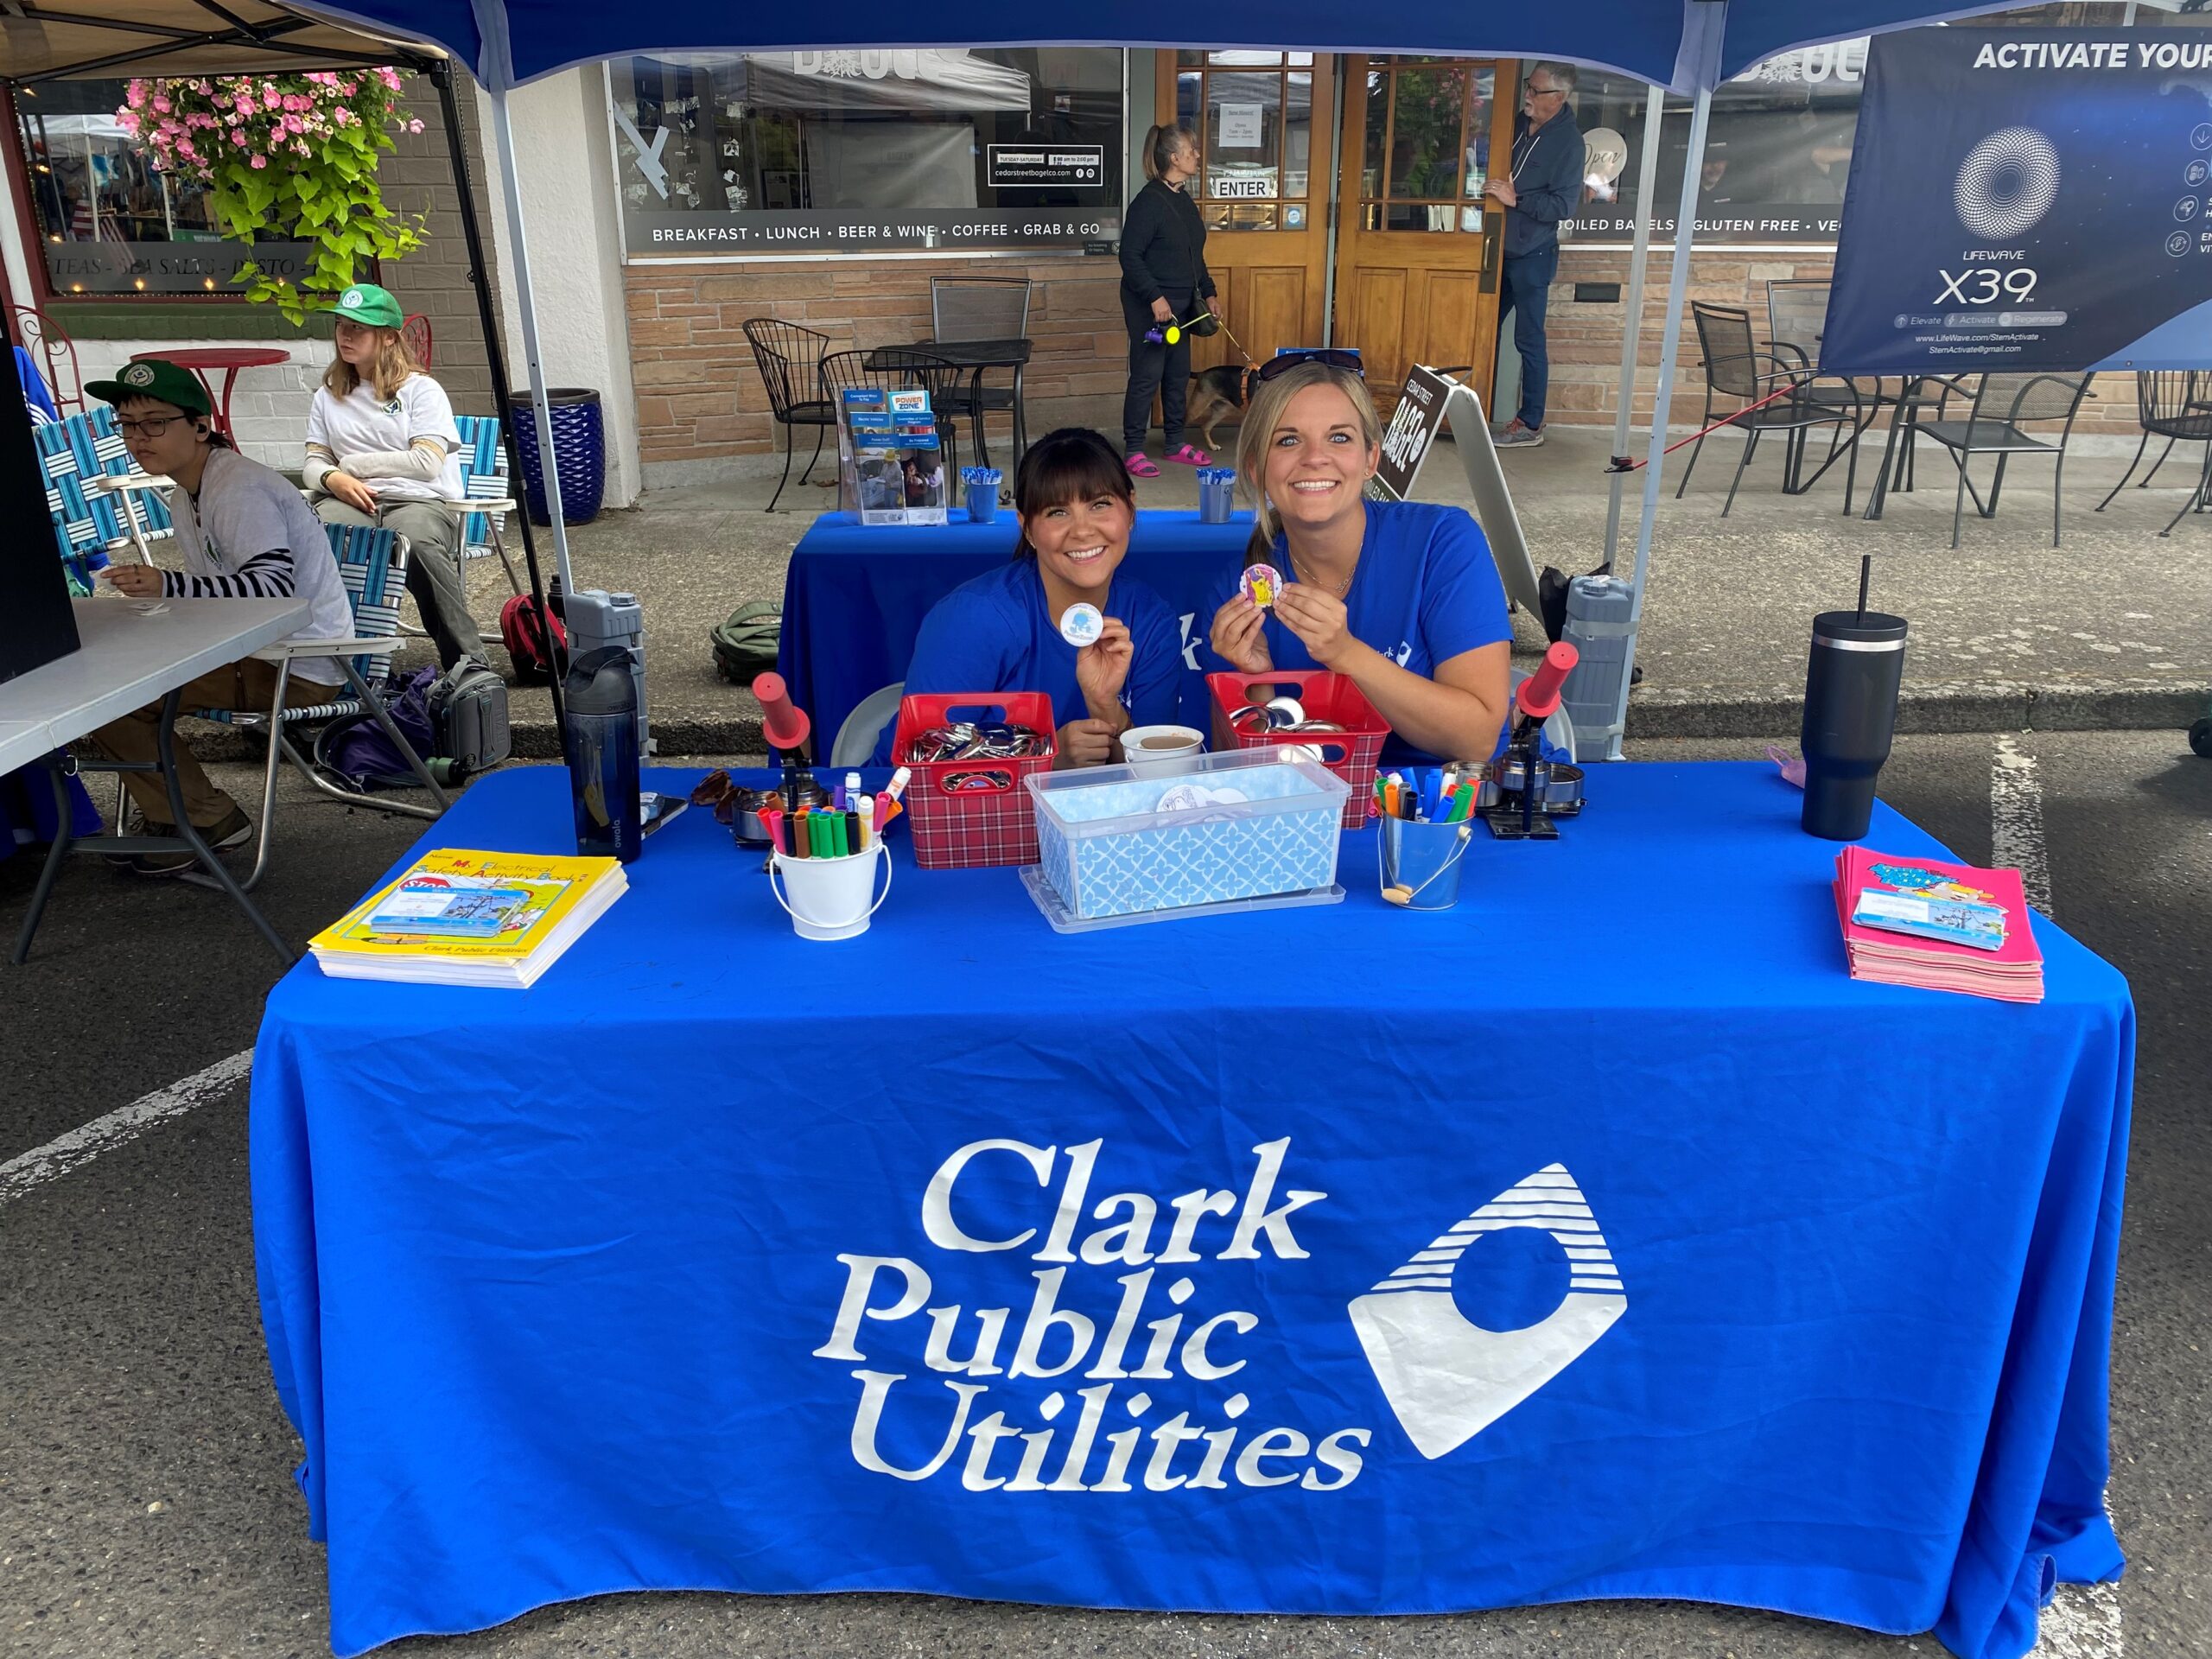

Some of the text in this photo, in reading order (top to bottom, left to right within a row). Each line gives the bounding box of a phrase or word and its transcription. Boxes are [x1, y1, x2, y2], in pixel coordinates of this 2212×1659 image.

[1973, 43, 2130, 68] ACTIVATE
[1219, 181, 1266, 196] ENTER
[652, 223, 1099, 242] BREAKFAST LUNCH BEER & WINE COFFEE GRAB & GO
[1615, 219, 1675, 231] BAELS
[1693, 219, 1755, 232] GLUTEN
[1760, 219, 1800, 232] FREE
[1963, 250, 2025, 261] LIFEWAVE
[54, 258, 101, 275] TEAS
[1932, 268, 2037, 304] X39
[1910, 315, 2064, 325] Elevate Activate Regenerate
[1915, 333, 2039, 342] www.LifeWave.com/StemActivate
[1929, 346, 2022, 354] StemActivate@gmail.com
[1407, 378, 1433, 406] CEDAR STREET
[413, 865, 465, 876] Safety
[471, 869, 537, 880] Activity
[452, 860, 556, 873] My Electrical
[921, 1135, 1327, 1264] Clark
[812, 1252, 1259, 1380] Public
[849, 1369, 1373, 1494] Utilities
